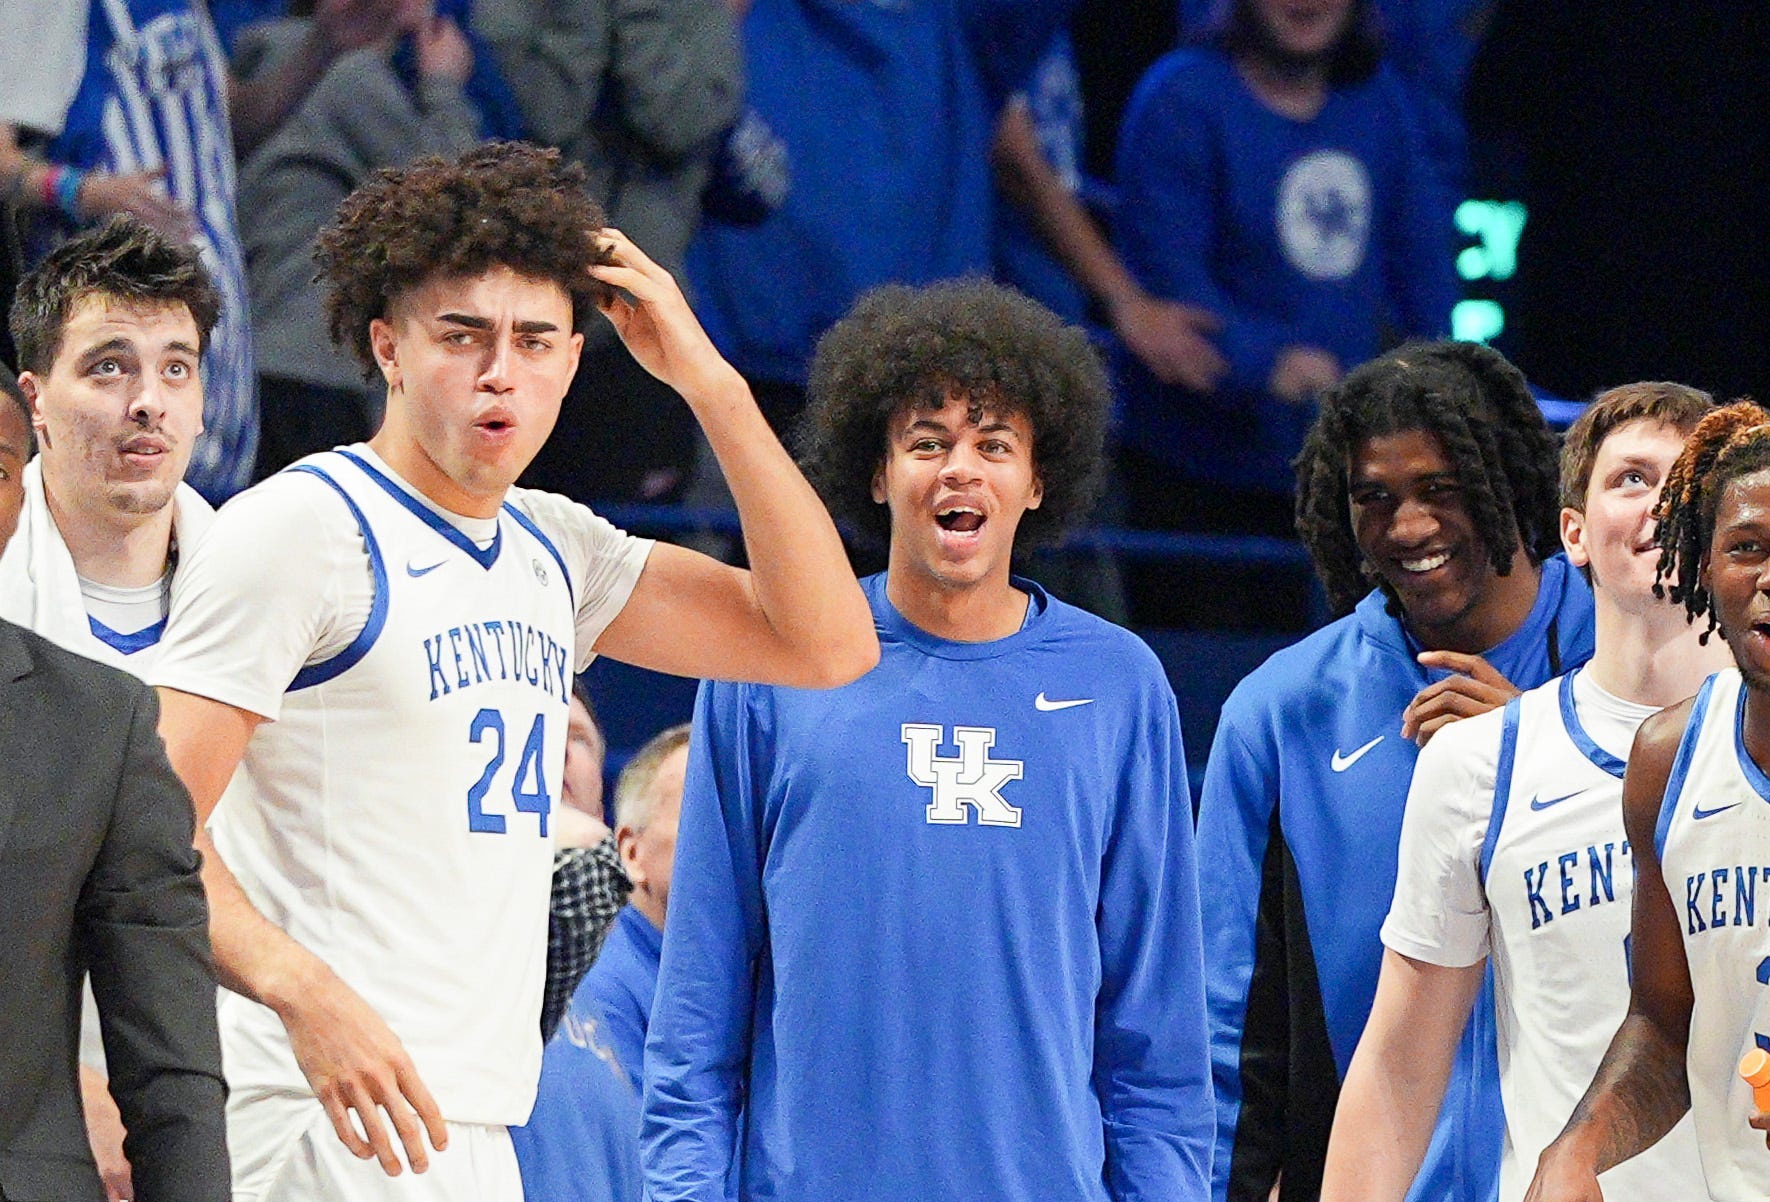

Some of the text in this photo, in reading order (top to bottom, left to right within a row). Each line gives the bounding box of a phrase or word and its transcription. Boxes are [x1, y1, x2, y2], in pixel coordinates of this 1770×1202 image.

[423, 620, 570, 706] KENTUCKY
[467, 708, 551, 837] 24
[901, 723, 1024, 828] UK
